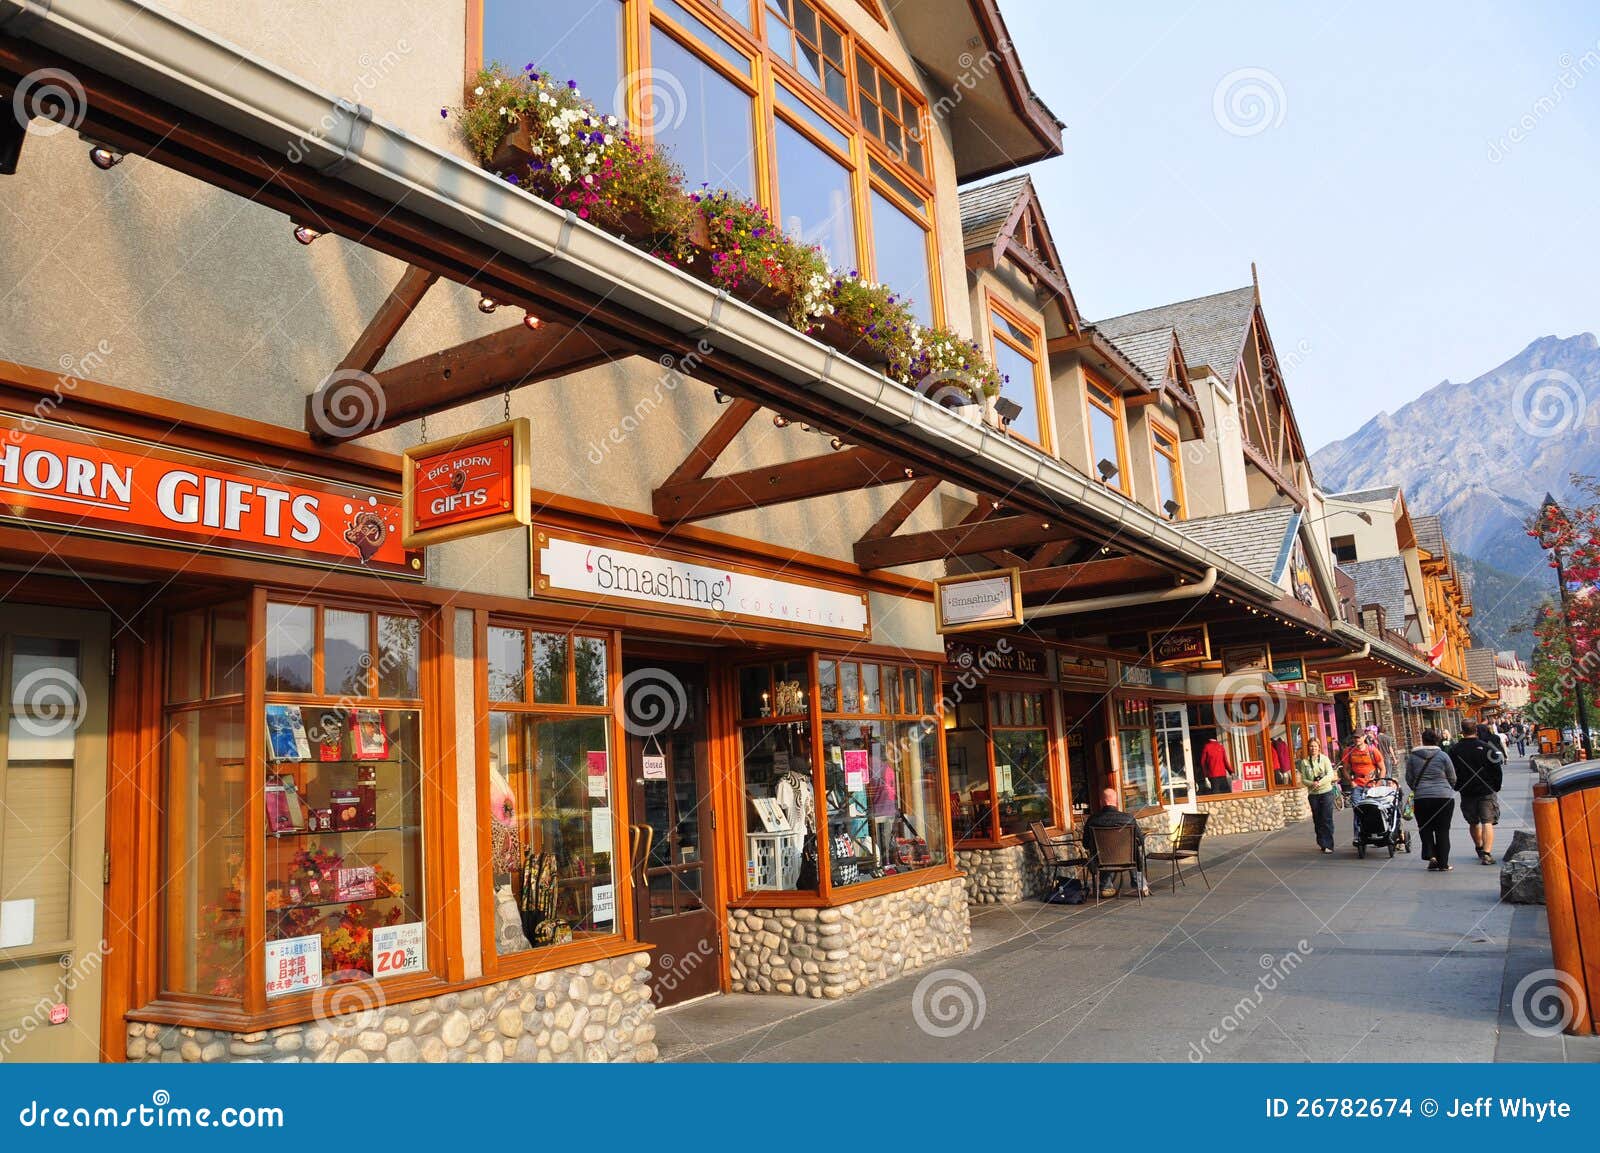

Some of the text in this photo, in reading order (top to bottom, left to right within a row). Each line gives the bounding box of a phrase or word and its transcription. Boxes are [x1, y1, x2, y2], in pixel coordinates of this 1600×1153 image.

[428, 456, 492, 480] BIG HORN
[156, 469, 322, 543] GIFTS
[431, 488, 488, 515] GIFTS
[1331, 675, 1347, 685] HH
[644, 760, 663, 769] closed
[1245, 765, 1262, 776] HH
